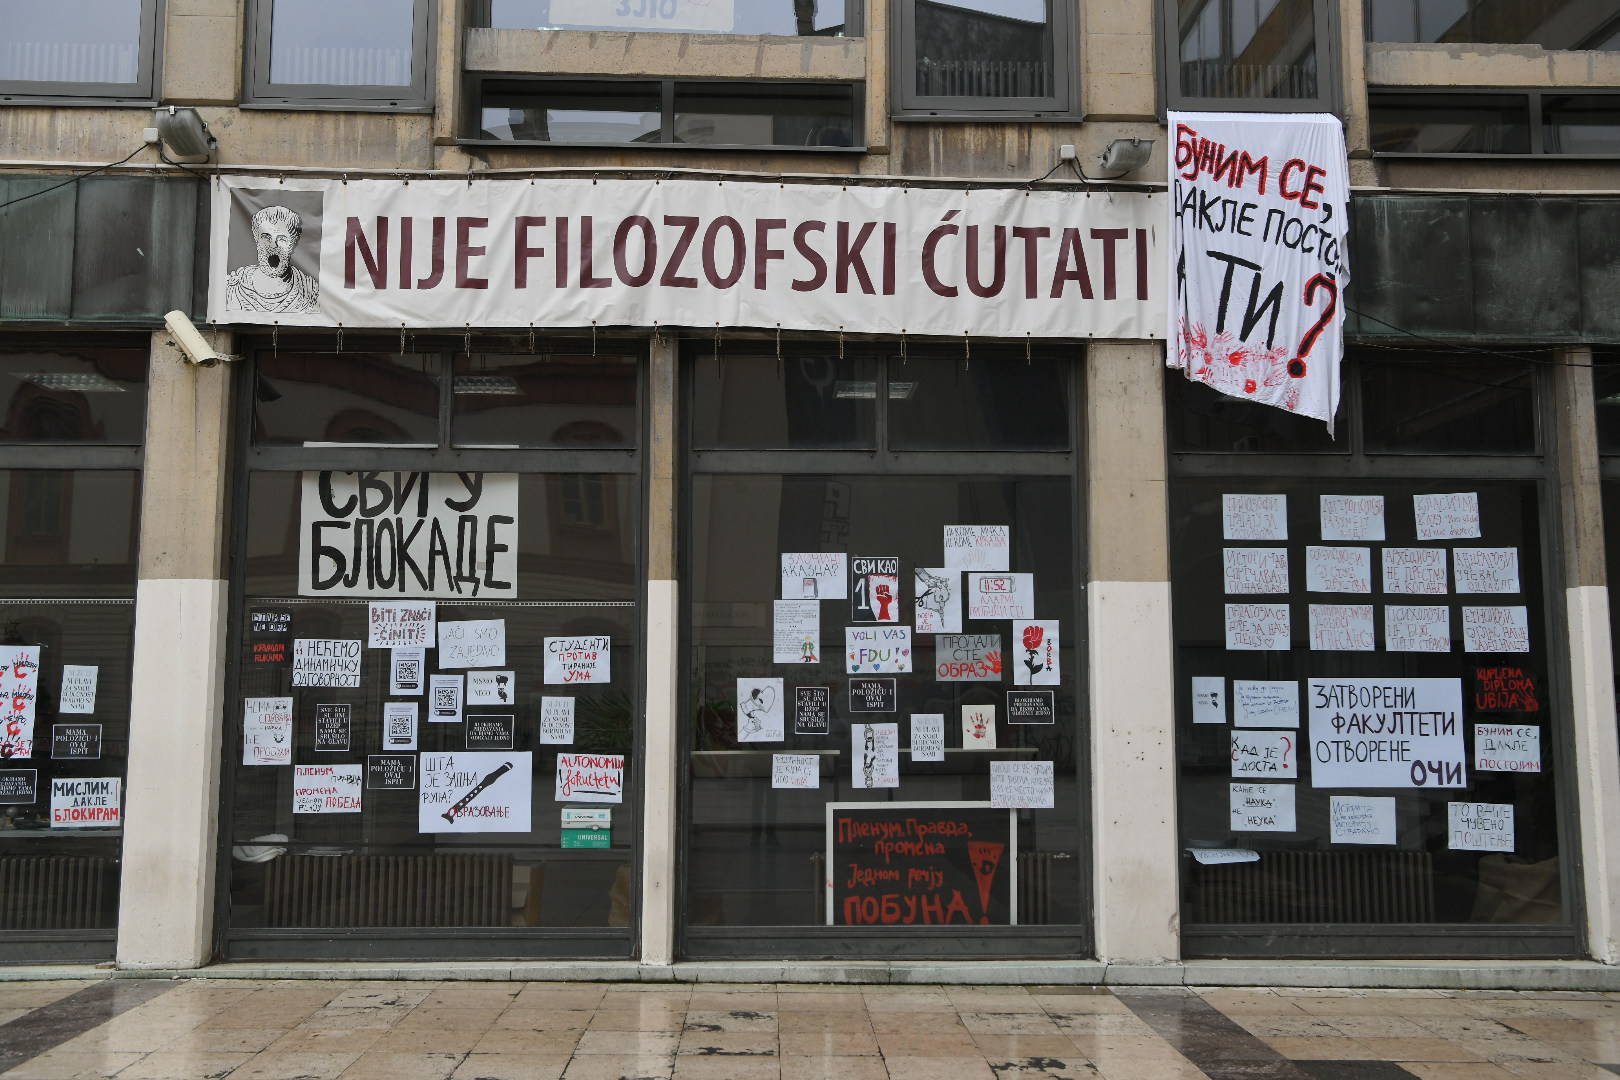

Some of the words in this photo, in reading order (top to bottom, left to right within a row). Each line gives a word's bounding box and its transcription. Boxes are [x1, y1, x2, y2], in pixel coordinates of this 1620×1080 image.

[1175, 124, 1268, 195] БУНИМ
[1279, 158, 1333, 224] СЕ,
[343, 215, 488, 290] NIJE
[514, 214, 896, 296] FILOZOFSKI
[921, 209, 1148, 301] ĆUTATI
[312, 514, 514, 597] БЛОКАДЕ
[853, 559, 875, 574] СВИ
[877, 559, 897, 574] КАО
[854, 578, 869, 610] 1
[852, 630, 876, 641] VOLI
[883, 629, 906, 639] VAS
[308, 641, 359, 657] НЕЋЕМО
[549, 637, 609, 653] СТУДЕНТИ
[559, 652, 597, 661] ПРОТИВ
[953, 649, 981, 661] СТЕ
[294, 659, 359, 672] ДИНАМИЧКУ
[562, 662, 596, 670] ТИРАНИЈЕ
[938, 660, 988, 678] ОБРАЗ
[293, 672, 359, 686] ОДГОВОРНОСТ
[563, 670, 591, 681] УМА
[1483, 678, 1534, 691] DIPLOMA
[1313, 684, 1415, 709] ЗАТВОРЕНИ
[1476, 692, 1519, 709] UBIJA
[1331, 711, 1455, 736] ФАКУЛТЕТИ
[1477, 727, 1513, 736] БУНИМ
[1264, 747, 1278, 759] ЈЕ
[1316, 740, 1411, 763] ОТВОРЕНЕ
[1482, 738, 1528, 754] ДАКЛЕ
[426, 756, 454, 771] ШТА
[1238, 761, 1278, 772] ДОСТА
[1480, 759, 1540, 770] ПОСТОЈИМ
[296, 767, 333, 776] ПЛЕНУМ
[1410, 760, 1462, 786] ОЧИ
[424, 774, 440, 788] ЈЕ
[71, 797, 107, 807] ДАКЛЕ
[325, 796, 361, 809] ПОБЕДА
[54, 807, 119, 821] БЛОКИРАМ
[448, 806, 510, 818] ОБРАЗОВАЊЕ
[1451, 804, 1469, 817] ТО
[1461, 818, 1504, 830] ЧУВЕНО
[875, 841, 945, 864] промена
[847, 863, 900, 888] Једном
[908, 867, 944, 891] речју
